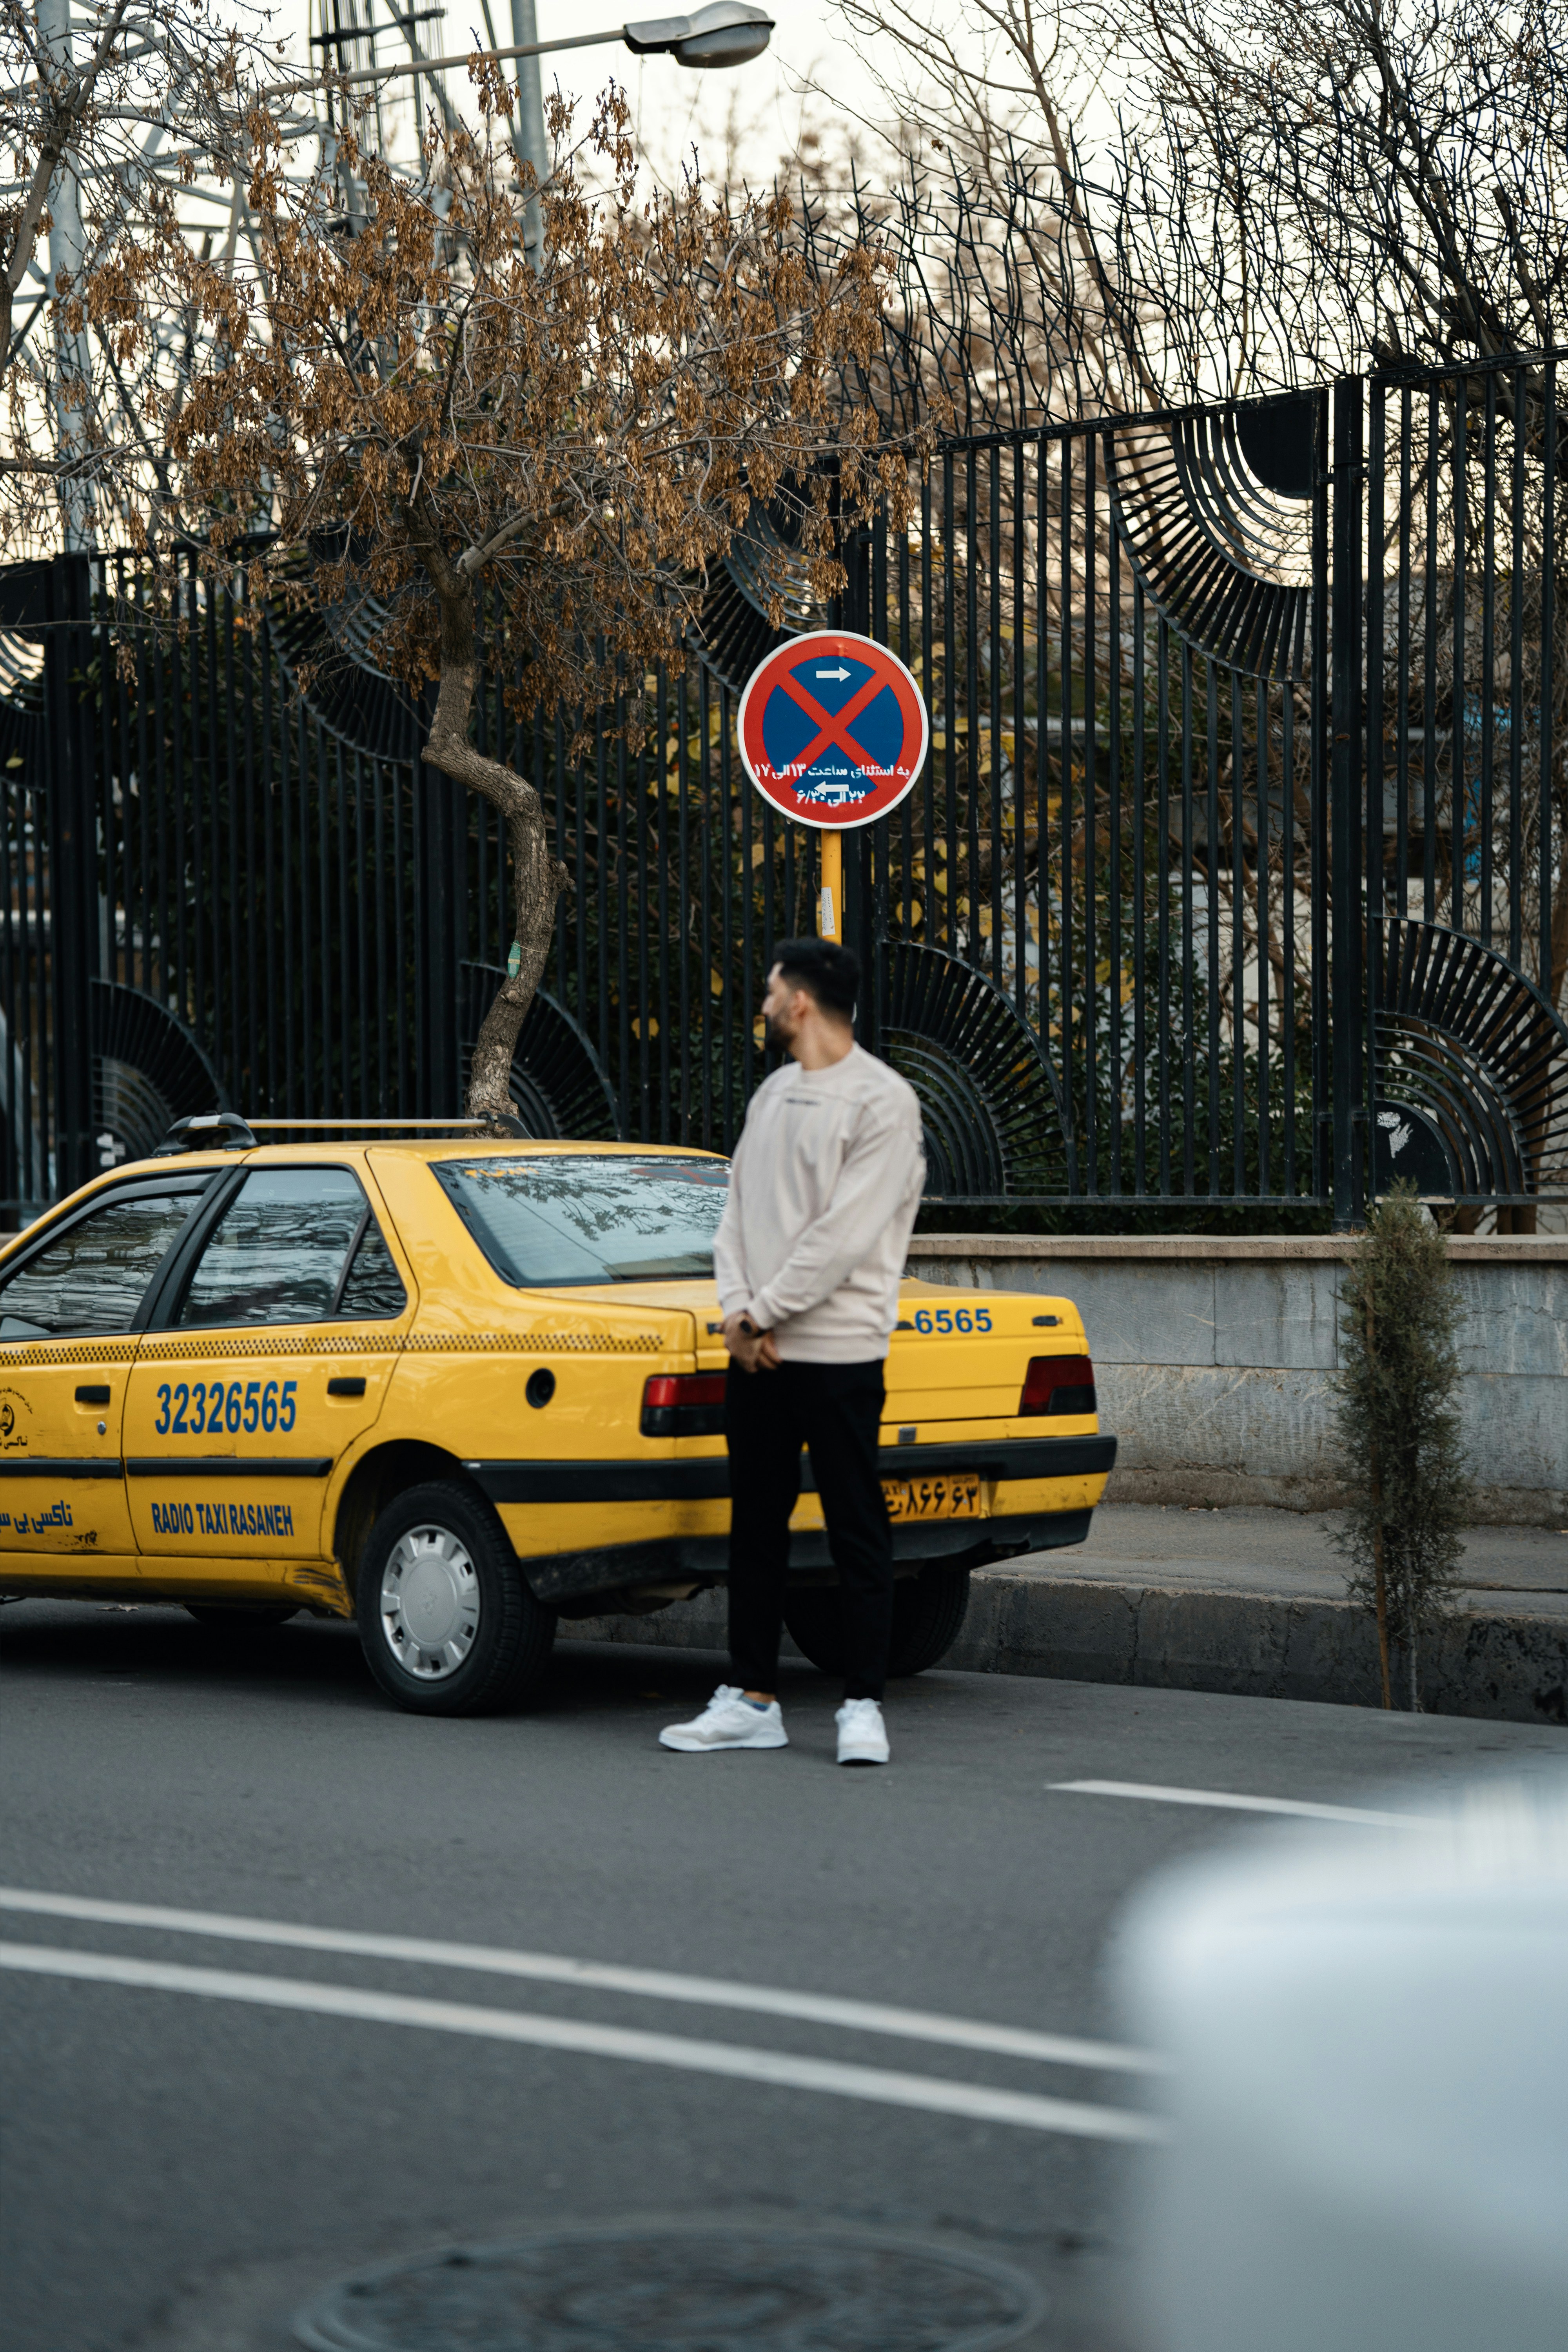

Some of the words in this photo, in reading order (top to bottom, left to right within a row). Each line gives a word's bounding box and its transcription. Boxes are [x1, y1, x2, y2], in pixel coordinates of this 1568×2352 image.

[808, 764, 848, 775] ساعت
[851, 764, 894, 779] استثنای
[915, 1309, 993, 1334] 6565
[155, 1381, 298, 1435] 32326565
[13, 1513, 31, 1534] بی
[31, 1500, 73, 1534] تاکسی
[151, 1503, 194, 1534] RADIO
[196, 1503, 229, 1534] TAXI
[229, 1504, 294, 1537] RASANEH
